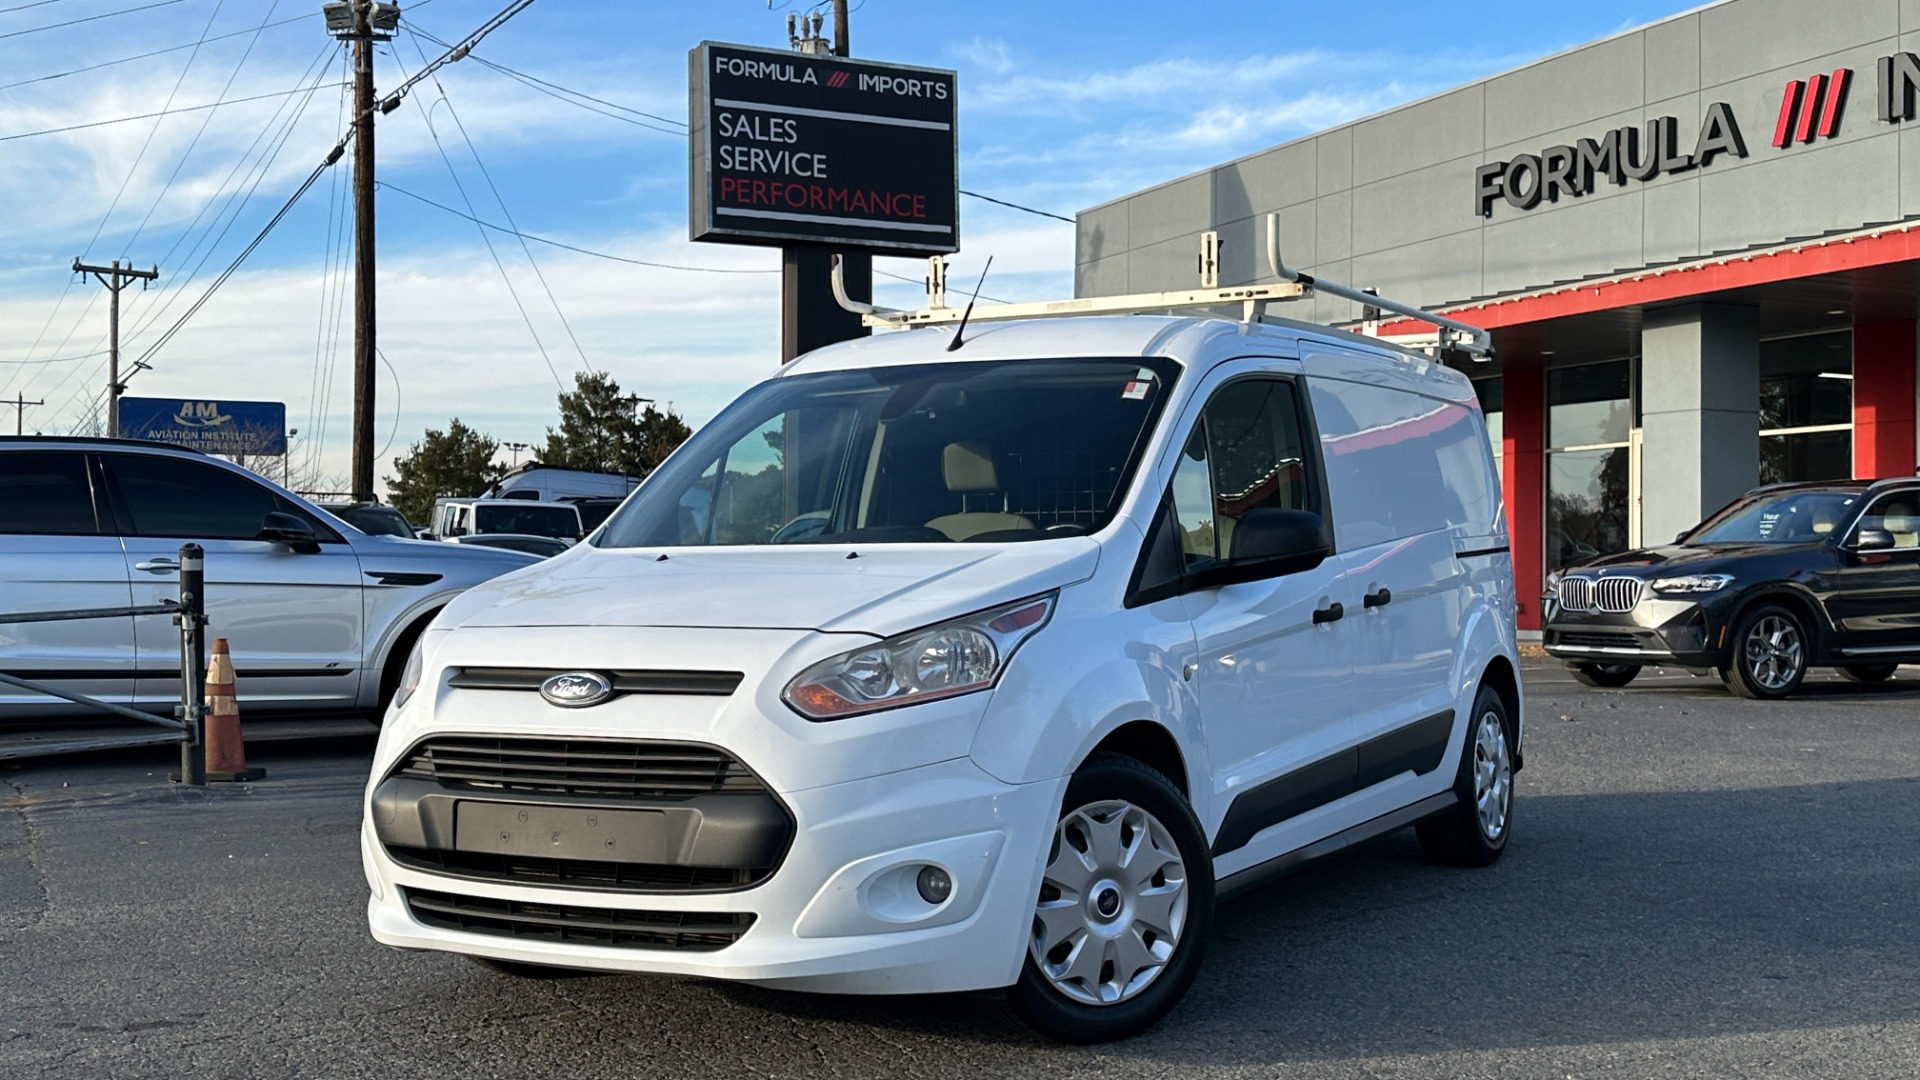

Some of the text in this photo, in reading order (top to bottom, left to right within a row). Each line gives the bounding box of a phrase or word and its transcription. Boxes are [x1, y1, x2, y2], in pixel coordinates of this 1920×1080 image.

[715, 56, 948, 100] FORMULA IMPORTS
[718, 112, 798, 144] SALES
[719, 145, 828, 179] SERVICE
[1475, 102, 1749, 219] FORMULA
[720, 177, 927, 218] PERFORMANCE
[147, 430, 257, 441] AVIATION INSTITUTE
[551, 676, 592, 698] Ford
